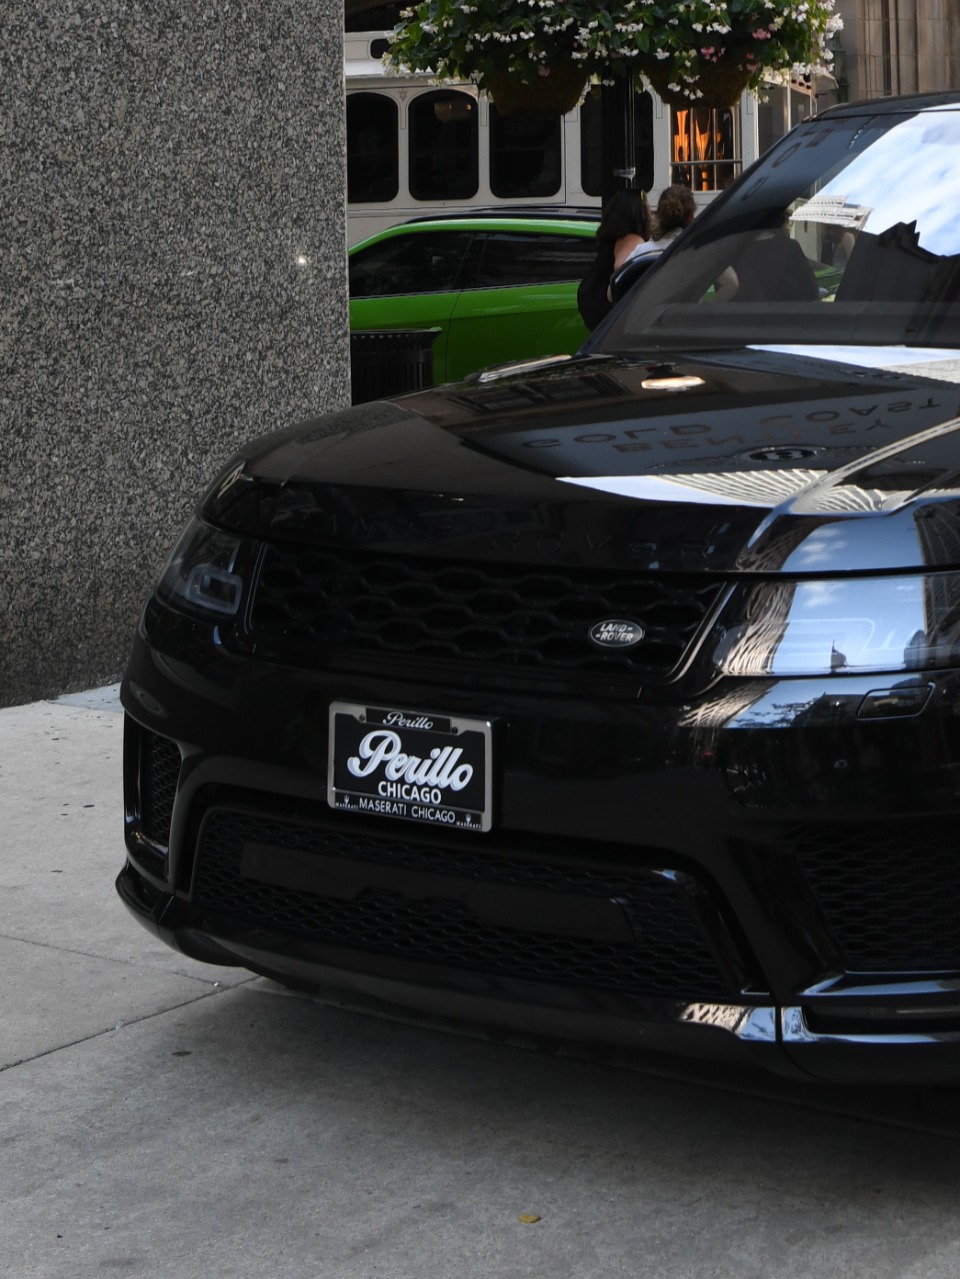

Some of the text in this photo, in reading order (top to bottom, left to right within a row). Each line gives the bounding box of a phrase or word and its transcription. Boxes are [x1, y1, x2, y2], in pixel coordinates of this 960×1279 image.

[383, 711, 433, 729] Perillo
[347, 730, 473, 791] Perillo
[378, 781, 441, 804] CHICAGO
[359, 797, 456, 823] MASERATI CHICAGO
